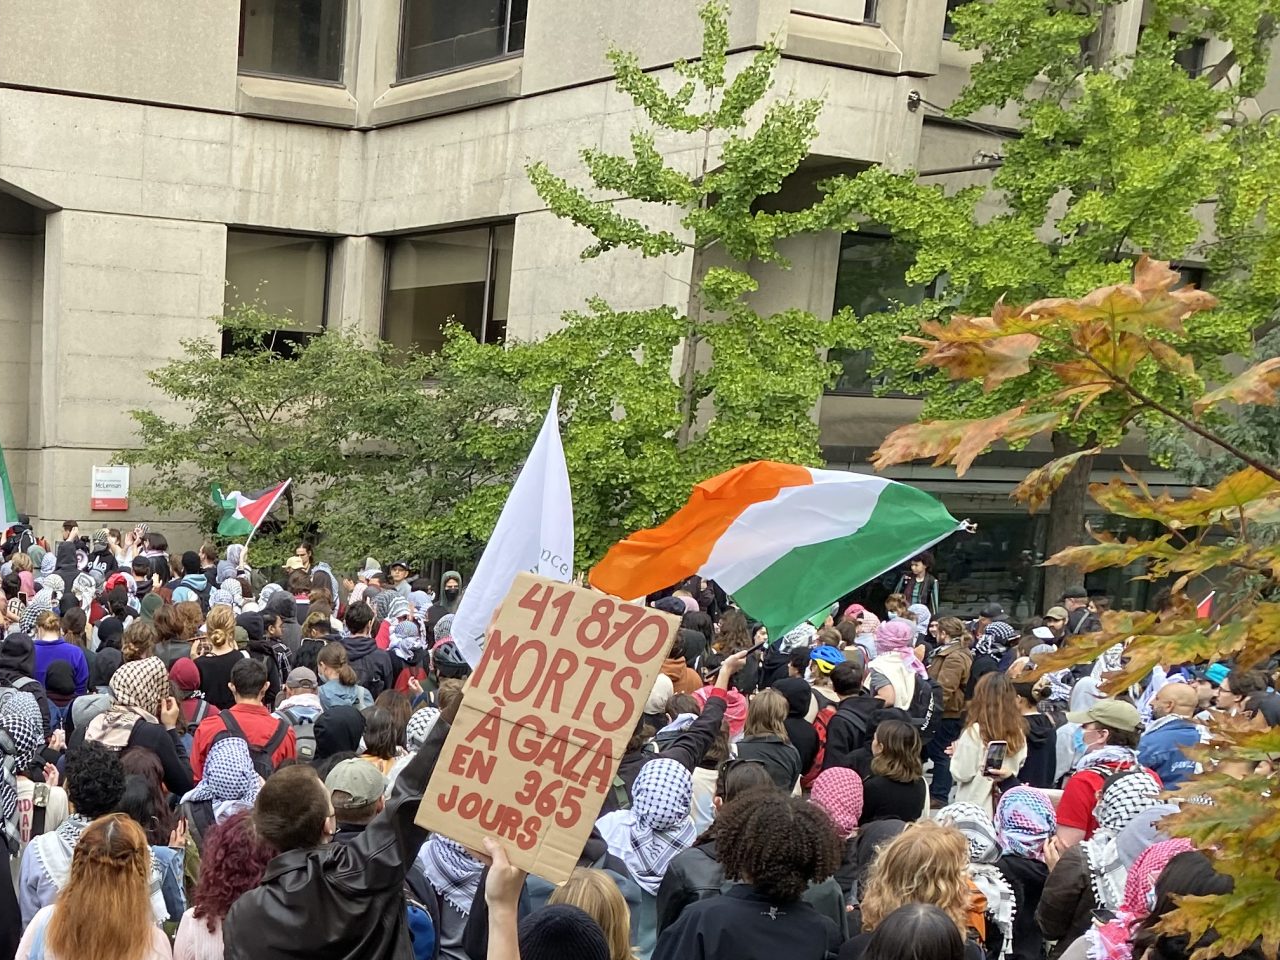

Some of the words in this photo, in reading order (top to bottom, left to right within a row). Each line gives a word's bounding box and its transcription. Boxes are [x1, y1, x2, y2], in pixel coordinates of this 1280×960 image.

[518, 582, 576, 637] 41
[576, 599, 670, 664] 870
[471, 630, 642, 732] MORTS
[448, 744, 497, 784] EN
[515, 770, 585, 828] 365
[465, 696, 505, 751] À
[508, 714, 615, 795] GAZA
[437, 785, 542, 851] JOURS
